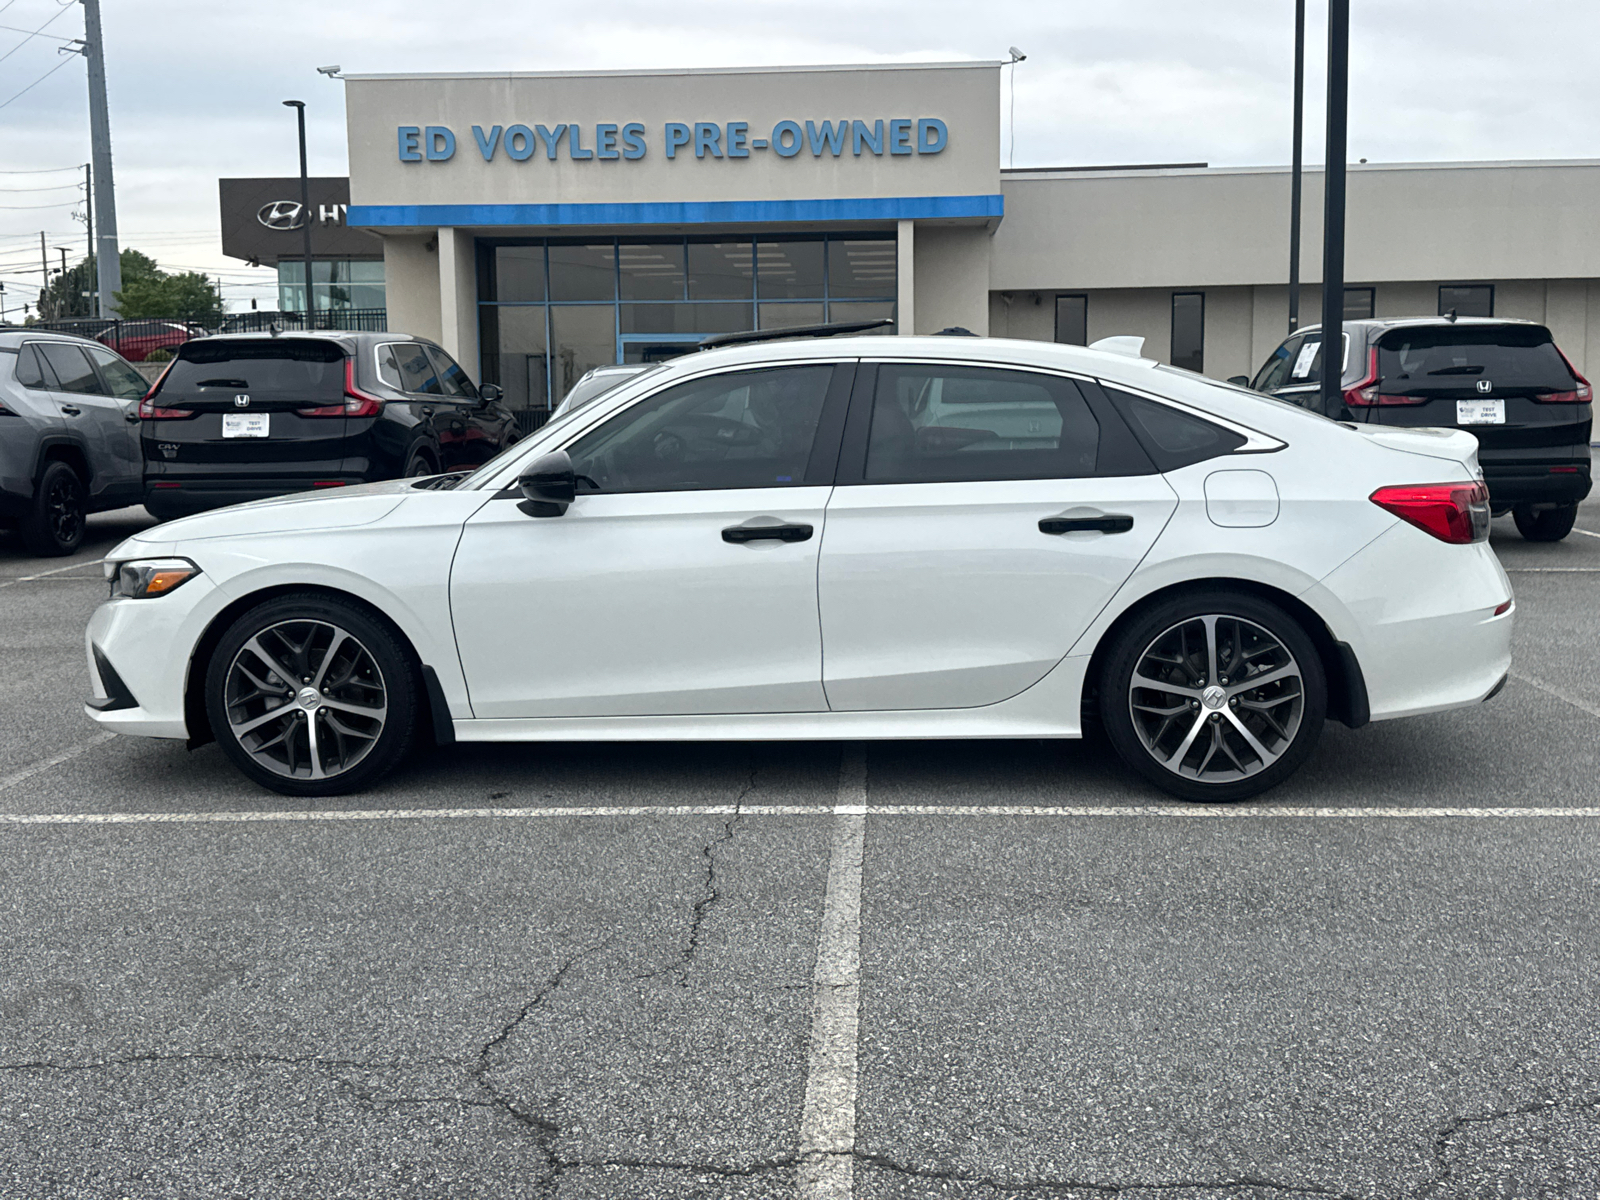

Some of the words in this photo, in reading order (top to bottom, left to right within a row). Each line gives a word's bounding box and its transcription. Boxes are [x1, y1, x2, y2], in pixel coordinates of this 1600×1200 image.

[397, 125, 457, 162] ED
[470, 122, 648, 162] VOYLES
[664, 117, 949, 159] PRE-OWNED
[319, 203, 347, 222] H
